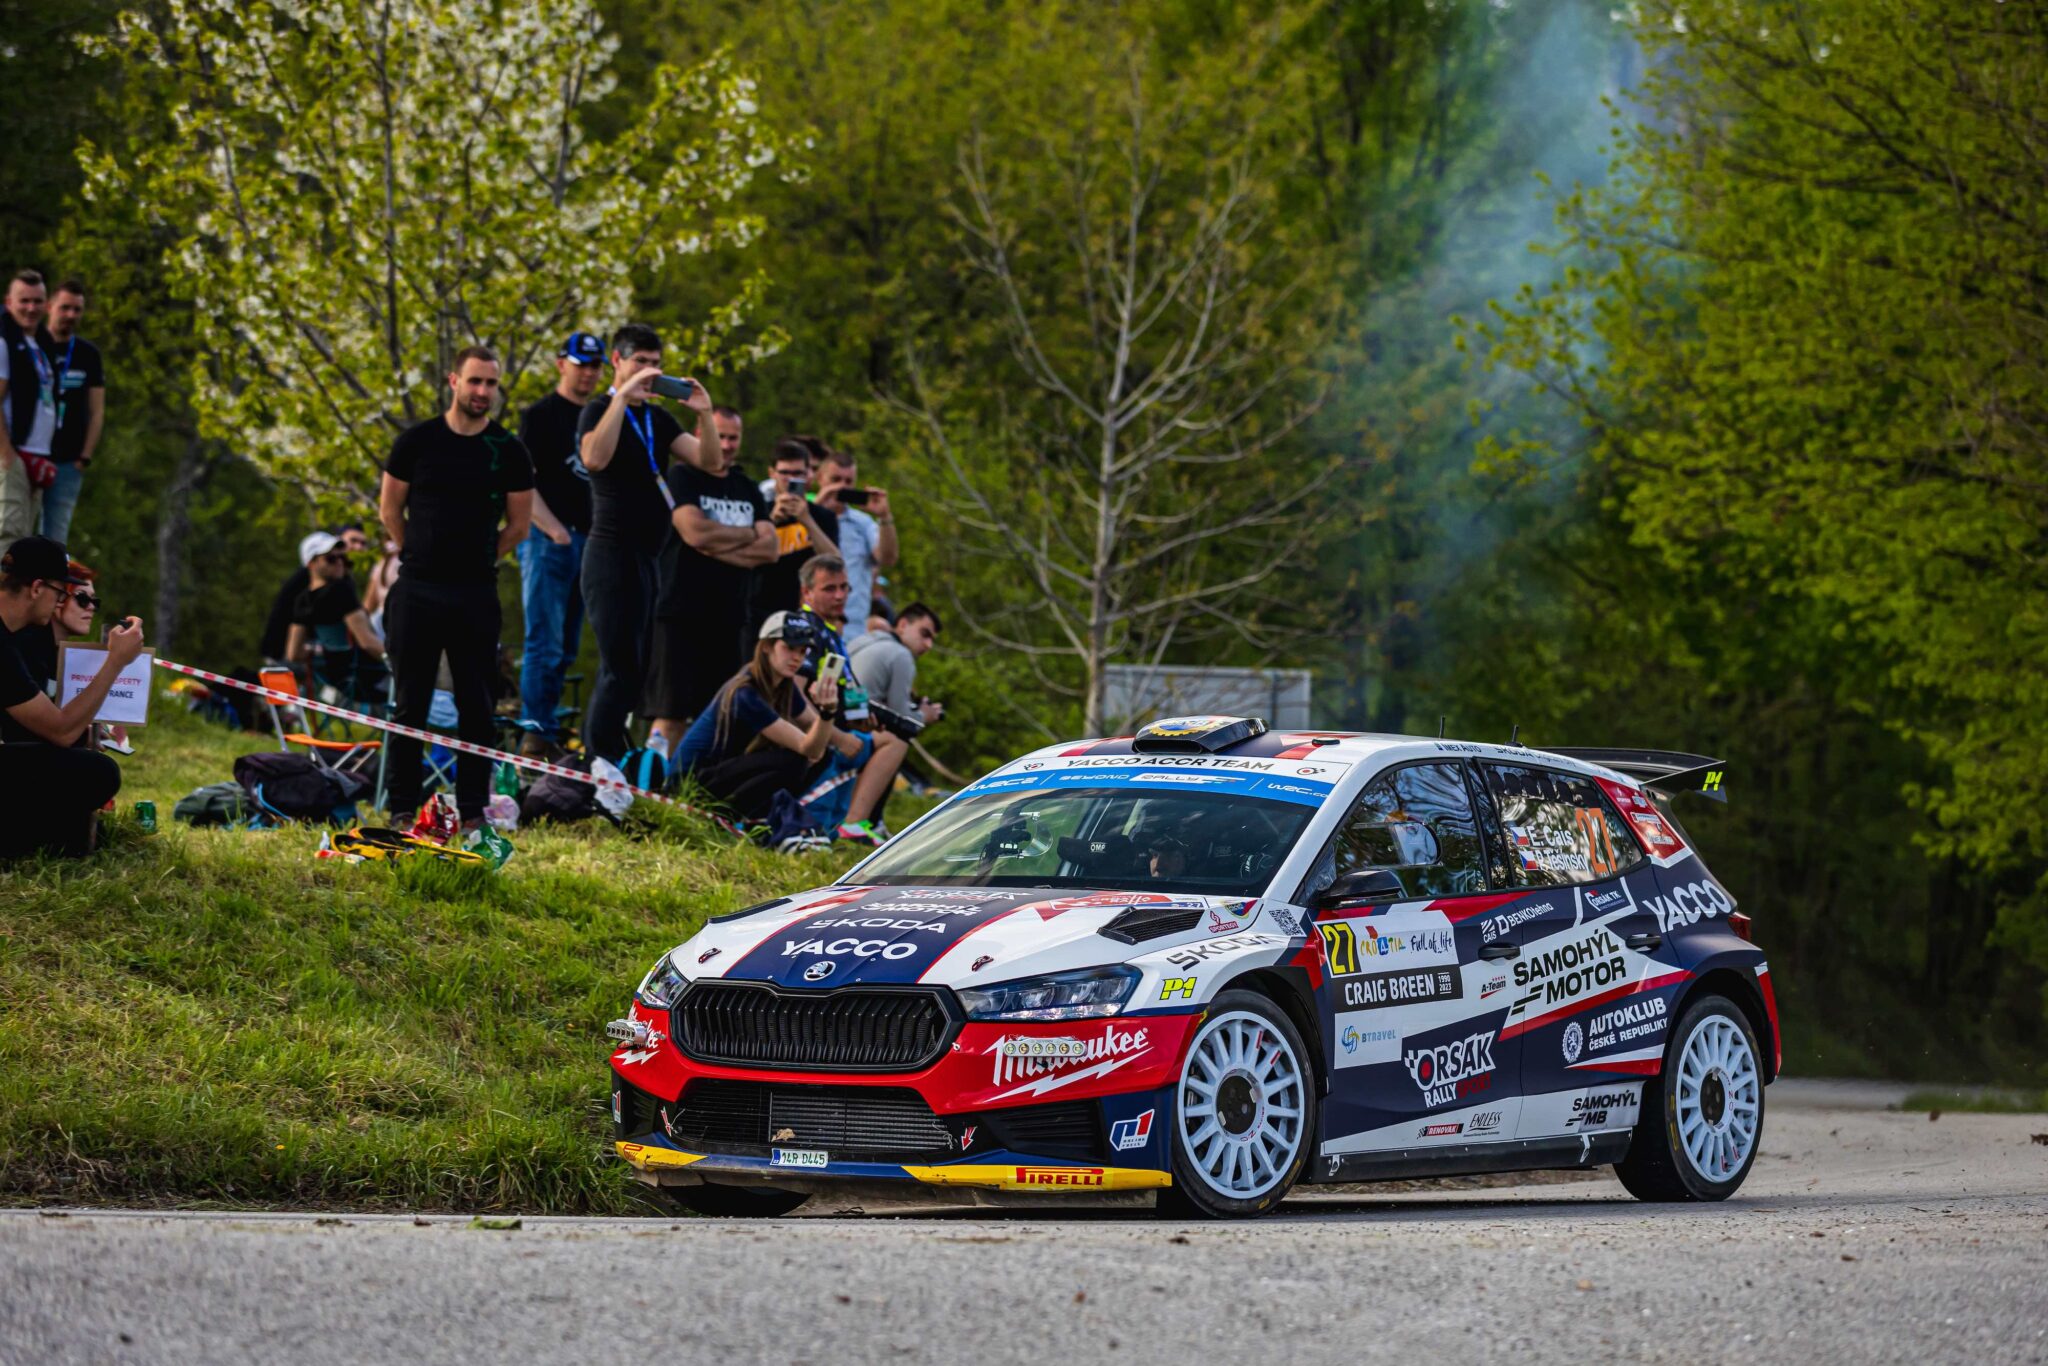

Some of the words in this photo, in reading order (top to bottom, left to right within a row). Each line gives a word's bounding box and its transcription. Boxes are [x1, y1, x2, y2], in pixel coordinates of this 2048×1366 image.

[71, 673, 98, 684] PRIVA
[109, 690, 134, 699] RANCE
[1068, 757, 1142, 767] YACCO
[1142, 757, 1207, 767] ACCR
[1211, 758, 1275, 772] TEAM
[1058, 774, 1131, 782] BEYOND
[1140, 774, 1202, 783] RALLY
[1090, 842, 1106, 852] OMP
[1543, 825, 1575, 847] Cais
[1574, 807, 1617, 874] 27
[1641, 879, 1732, 934] YACCO
[1410, 934, 1429, 951] Full
[1429, 932, 1439, 953] of
[1439, 930, 1453, 953] life
[1483, 930, 1497, 944] CAIS
[780, 938, 918, 960] YACCO
[1322, 923, 1355, 975] 27
[1513, 928, 1620, 987] SAMOHÝL
[1159, 976, 1198, 1001] P1
[1344, 978, 1387, 1006] CRAIG
[1388, 973, 1436, 1000] BREEN
[1438, 974, 1451, 983] 1990
[1439, 983, 1452, 992] 2023
[1546, 955, 1627, 1005] MOTOR
[1588, 997, 1667, 1037] AUTOKLUB
[1588, 1034, 1617, 1052] ČESKÉ
[1619, 1017, 1668, 1042] REPUBLIKY
[1572, 1088, 1638, 1112] SAMOHÝL
[1469, 1111, 1503, 1128] ENDLESS
[1584, 1110, 1608, 1126] MB
[1428, 1125, 1457, 1135] RENOVAK
[1016, 1166, 1105, 1186] PIRELLI
